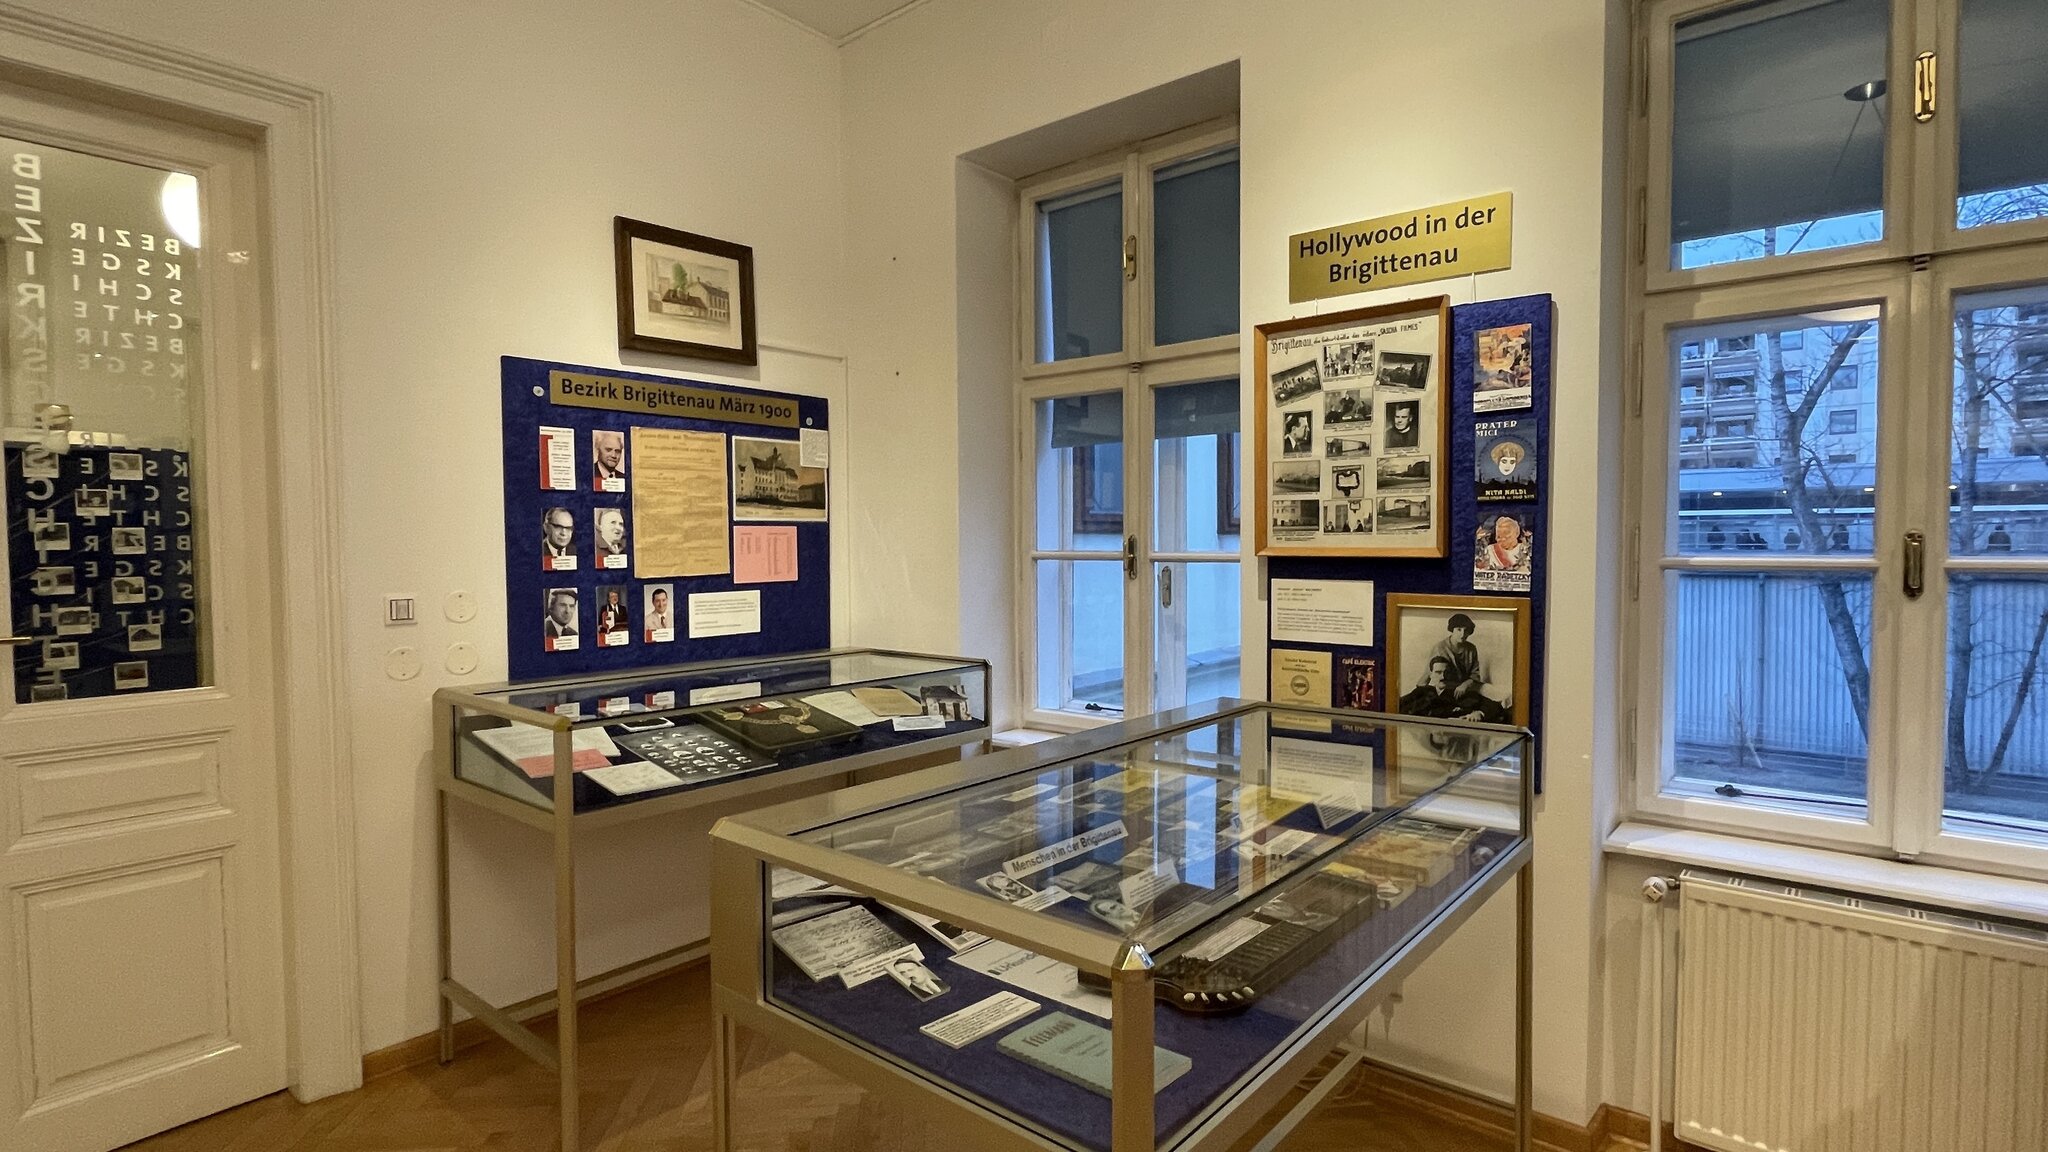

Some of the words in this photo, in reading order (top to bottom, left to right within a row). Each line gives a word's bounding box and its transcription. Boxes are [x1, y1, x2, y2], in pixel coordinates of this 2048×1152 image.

[1300, 216, 1417, 258] Hollywood
[1425, 214, 1447, 235] in
[1455, 206, 1496, 229] der
[1329, 247, 1458, 284] Brigittenau
[561, 378, 618, 400] Bezirk
[623, 385, 715, 409] Brigittenau
[719, 398, 756, 414] März
[760, 404, 792, 419] 1900
